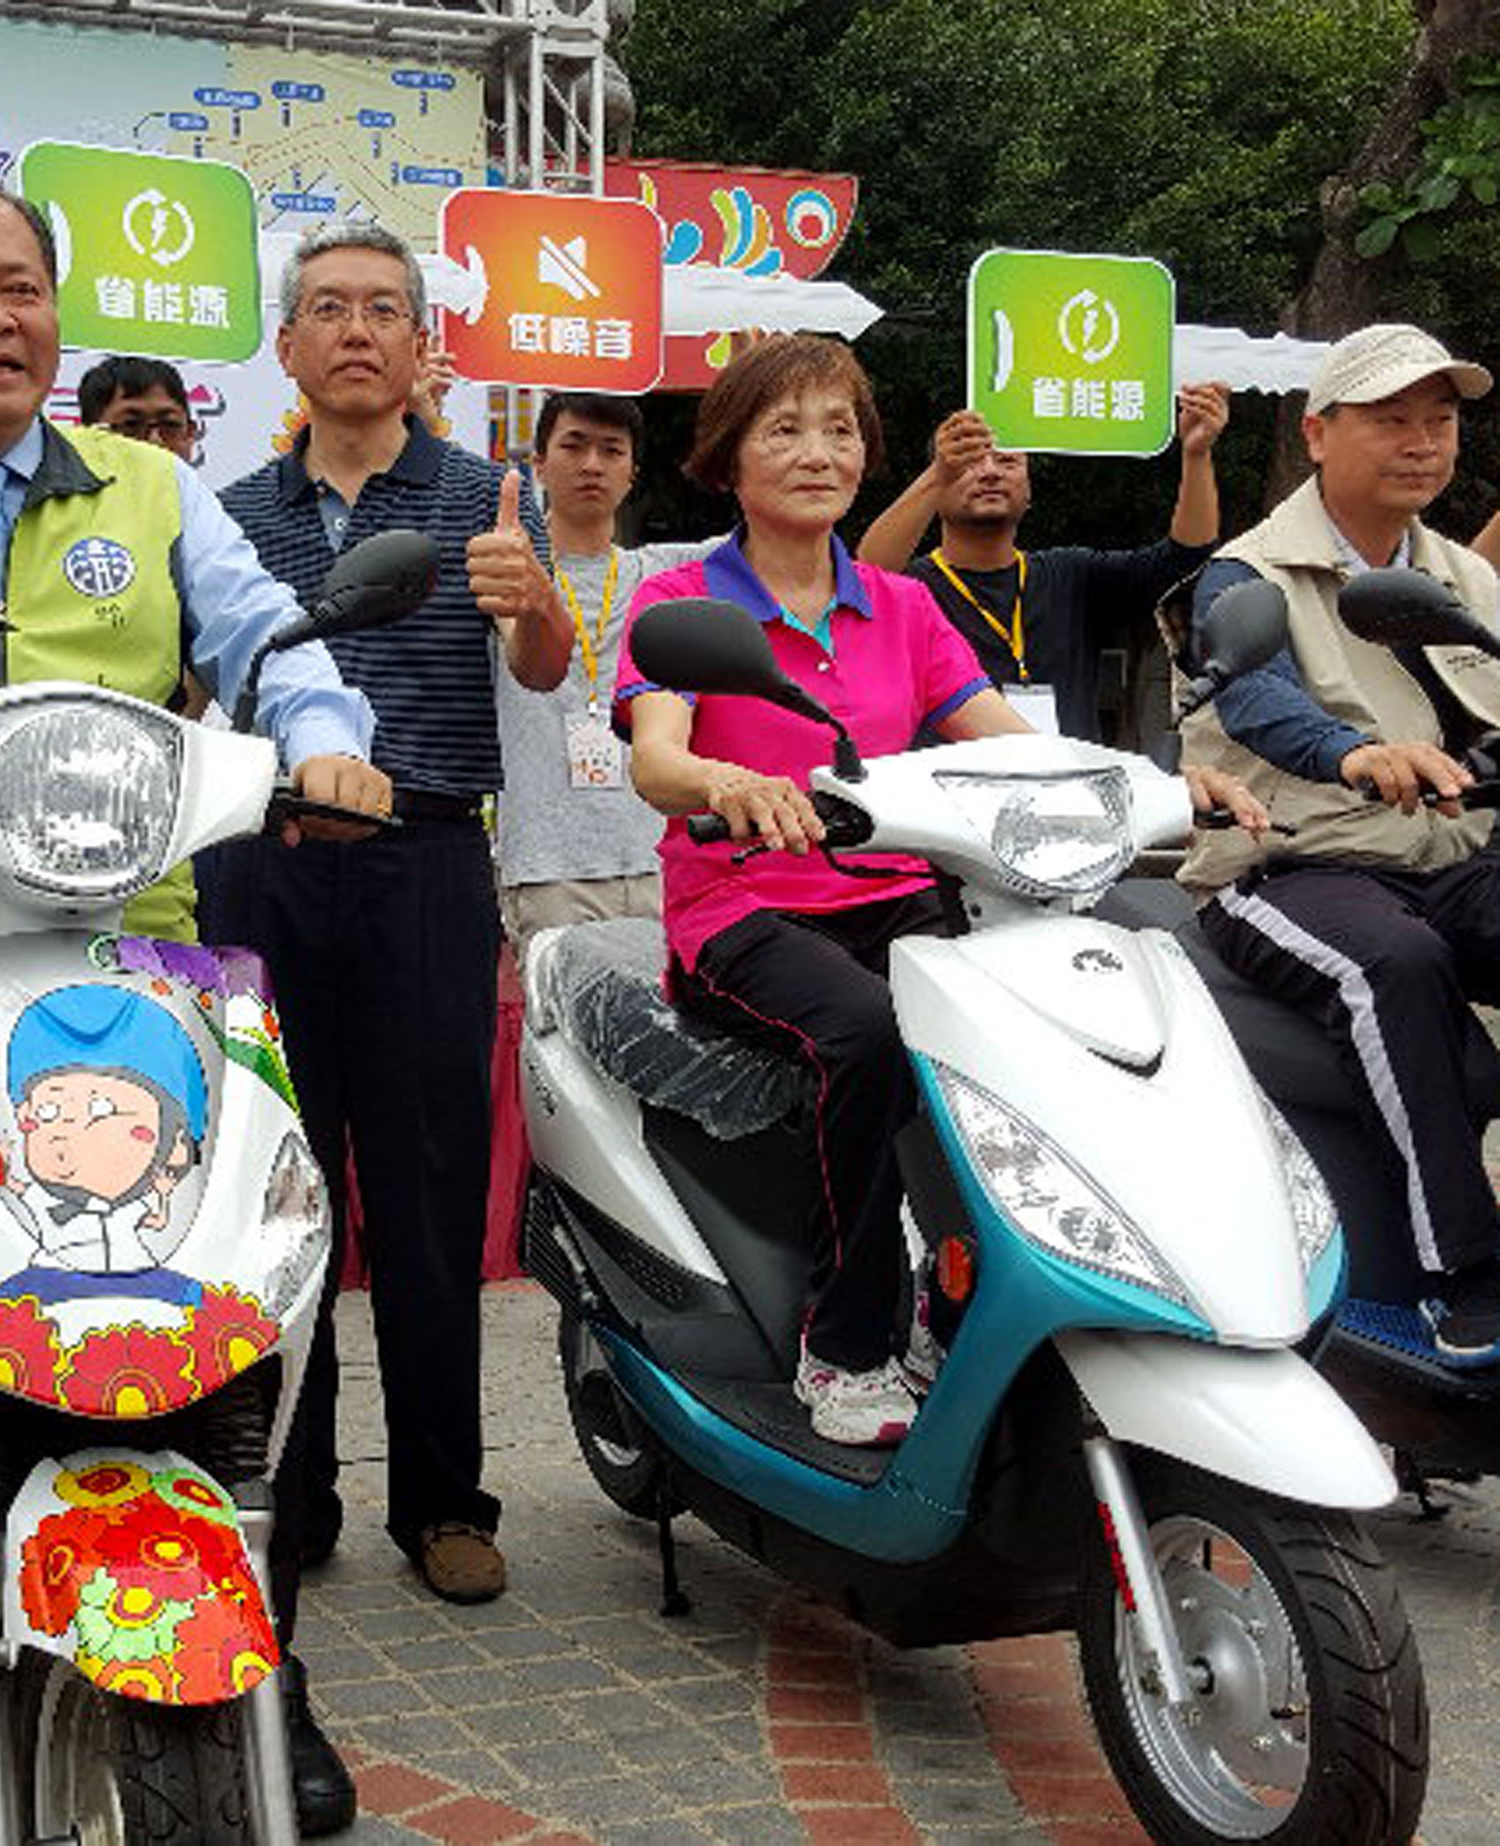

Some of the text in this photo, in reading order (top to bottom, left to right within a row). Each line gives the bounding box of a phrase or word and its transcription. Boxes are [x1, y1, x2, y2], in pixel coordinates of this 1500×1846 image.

[95, 276, 231, 330] 省能源
[508, 313, 633, 361] 低噪音
[1033, 377, 1145, 420] 省能源
